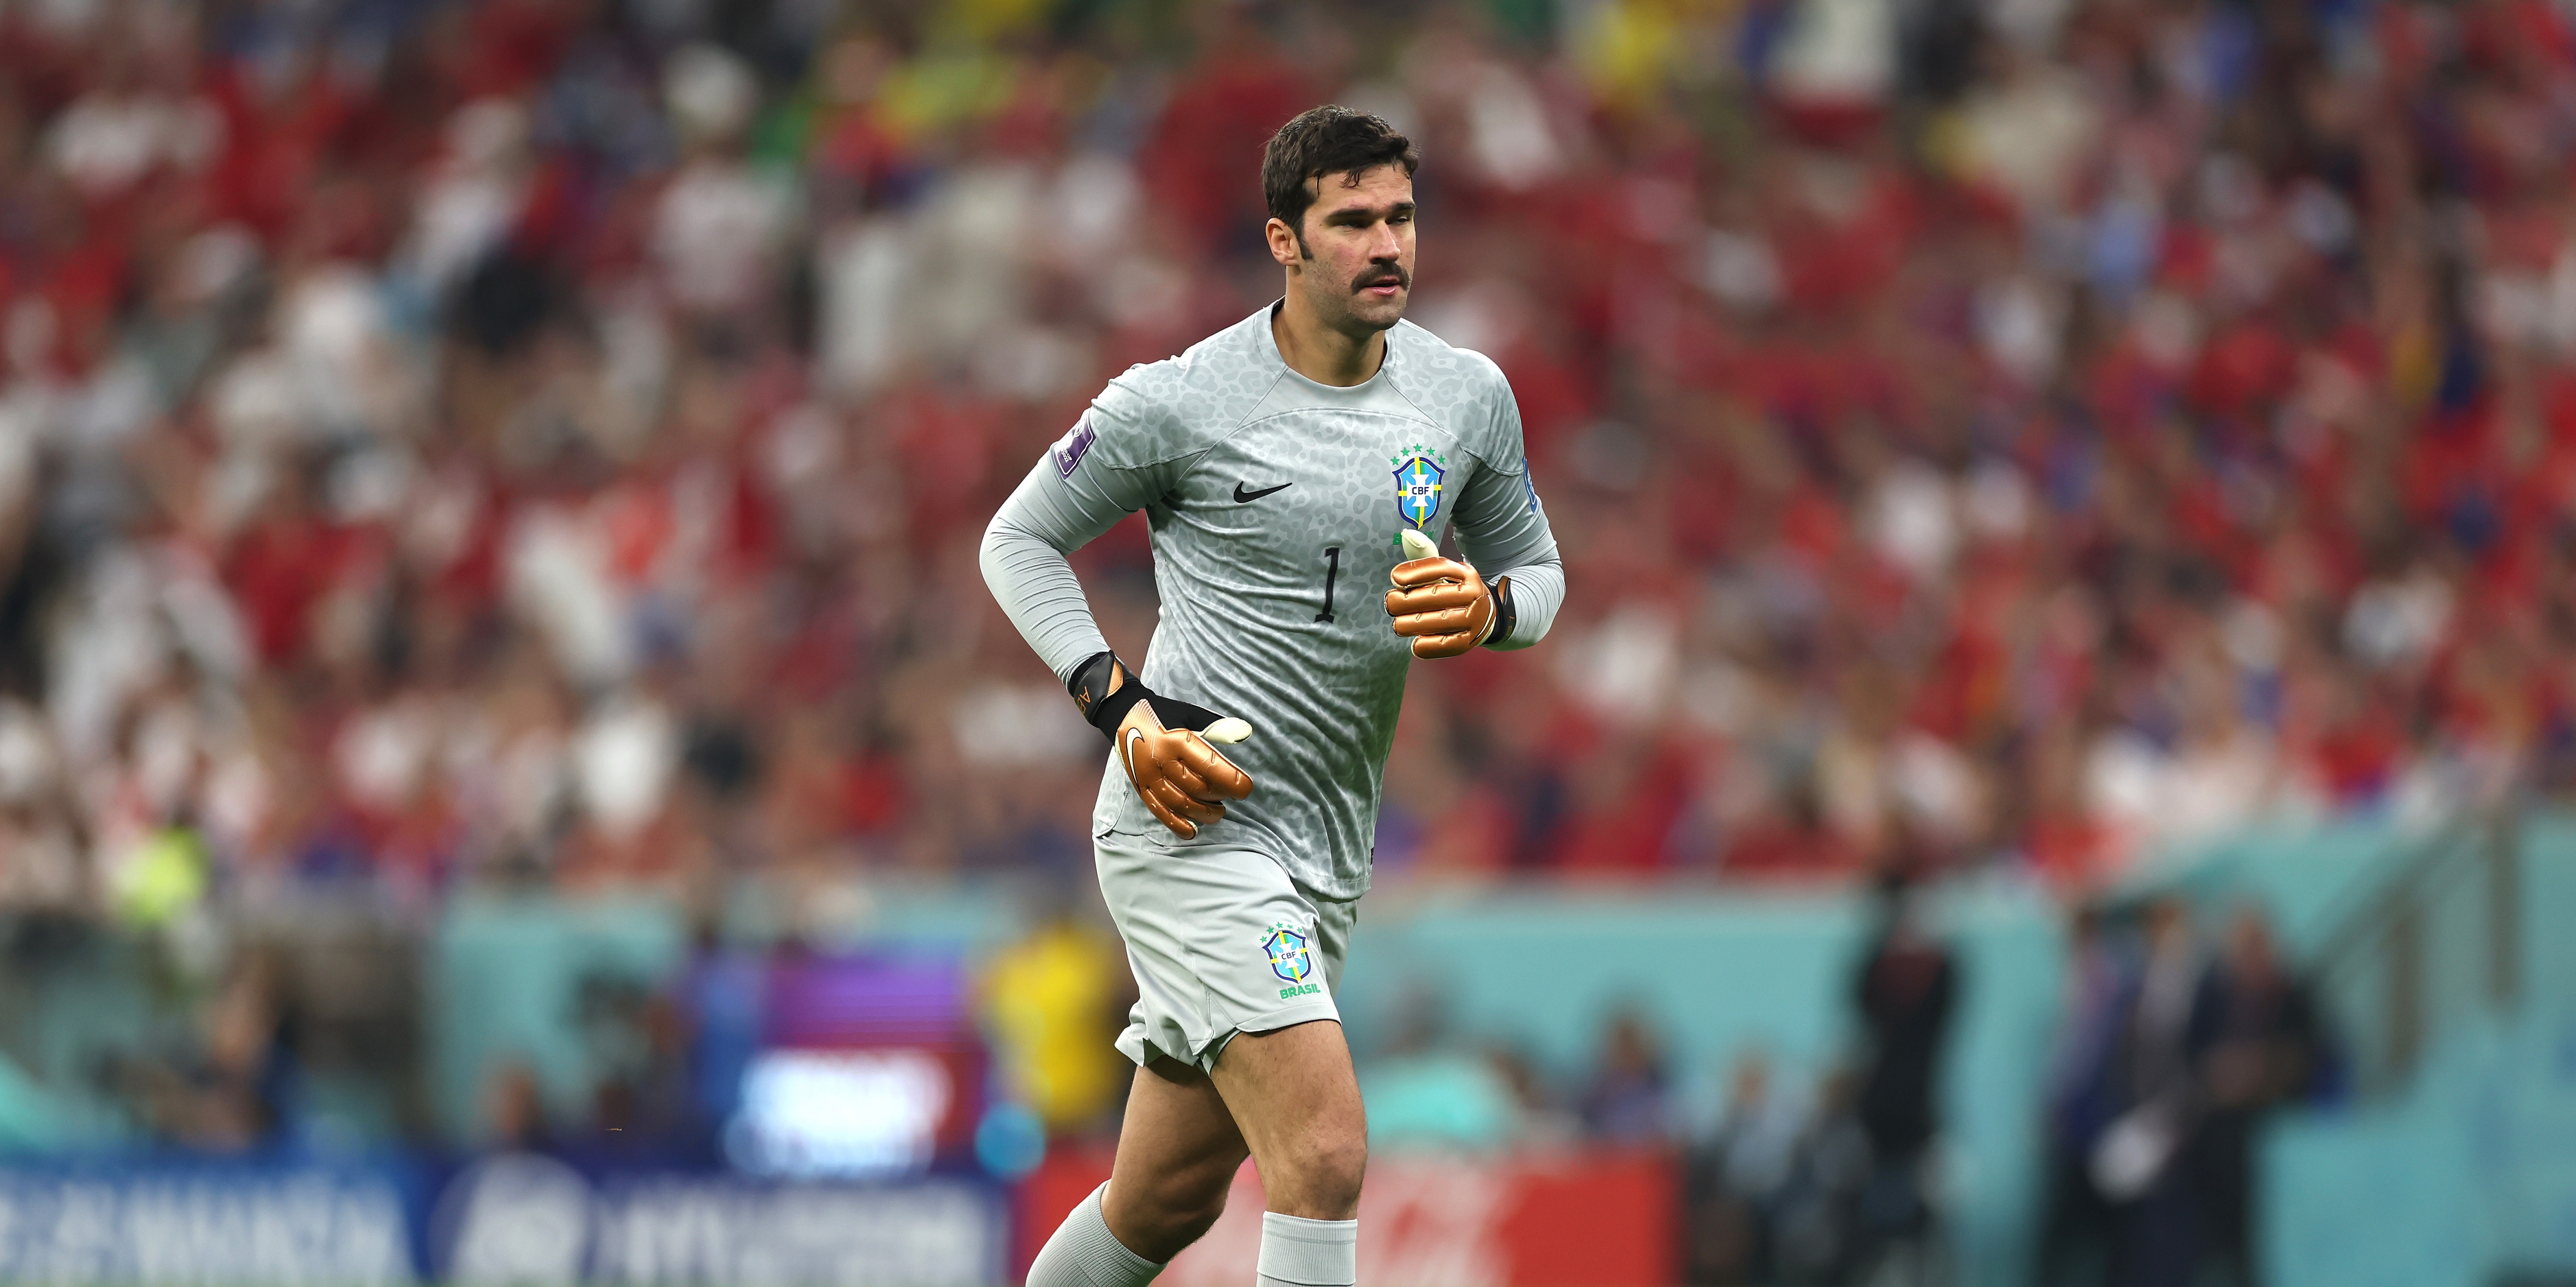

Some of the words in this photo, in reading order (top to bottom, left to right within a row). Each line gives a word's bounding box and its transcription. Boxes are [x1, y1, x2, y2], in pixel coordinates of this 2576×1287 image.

[1412, 487, 1429, 495] CBF
[1314, 547, 1340, 623] 1
[1281, 951, 1296, 960] CBF
[1280, 983, 1320, 1000] BRASIL
